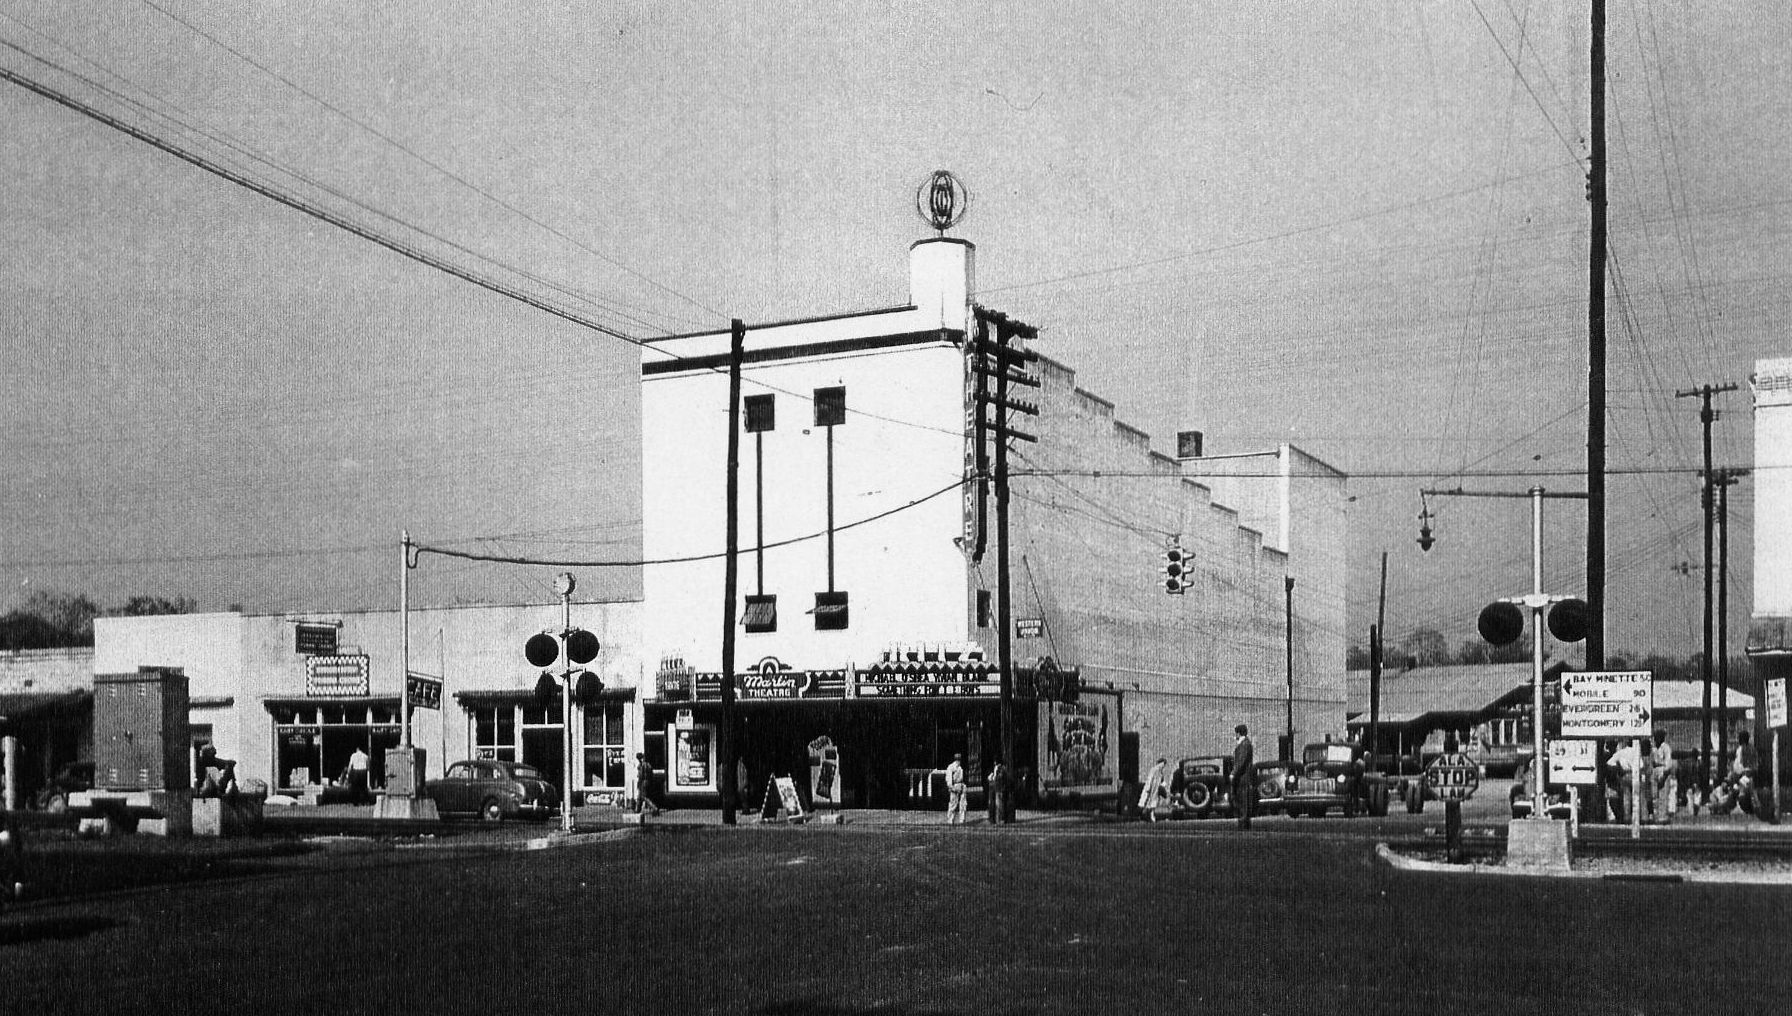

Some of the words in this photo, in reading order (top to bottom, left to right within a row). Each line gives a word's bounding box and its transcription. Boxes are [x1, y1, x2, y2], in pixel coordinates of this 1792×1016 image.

[1573, 675, 1592, 683] BAY
[1596, 675, 1638, 683] MINETTE
[1573, 690, 1609, 698] MOBILE
[1633, 689, 1646, 697] 90
[1562, 704, 1620, 713] EVERGREEN
[1562, 720, 1625, 728] MONTGOMERY
[1429, 768, 1477, 786] STOP
